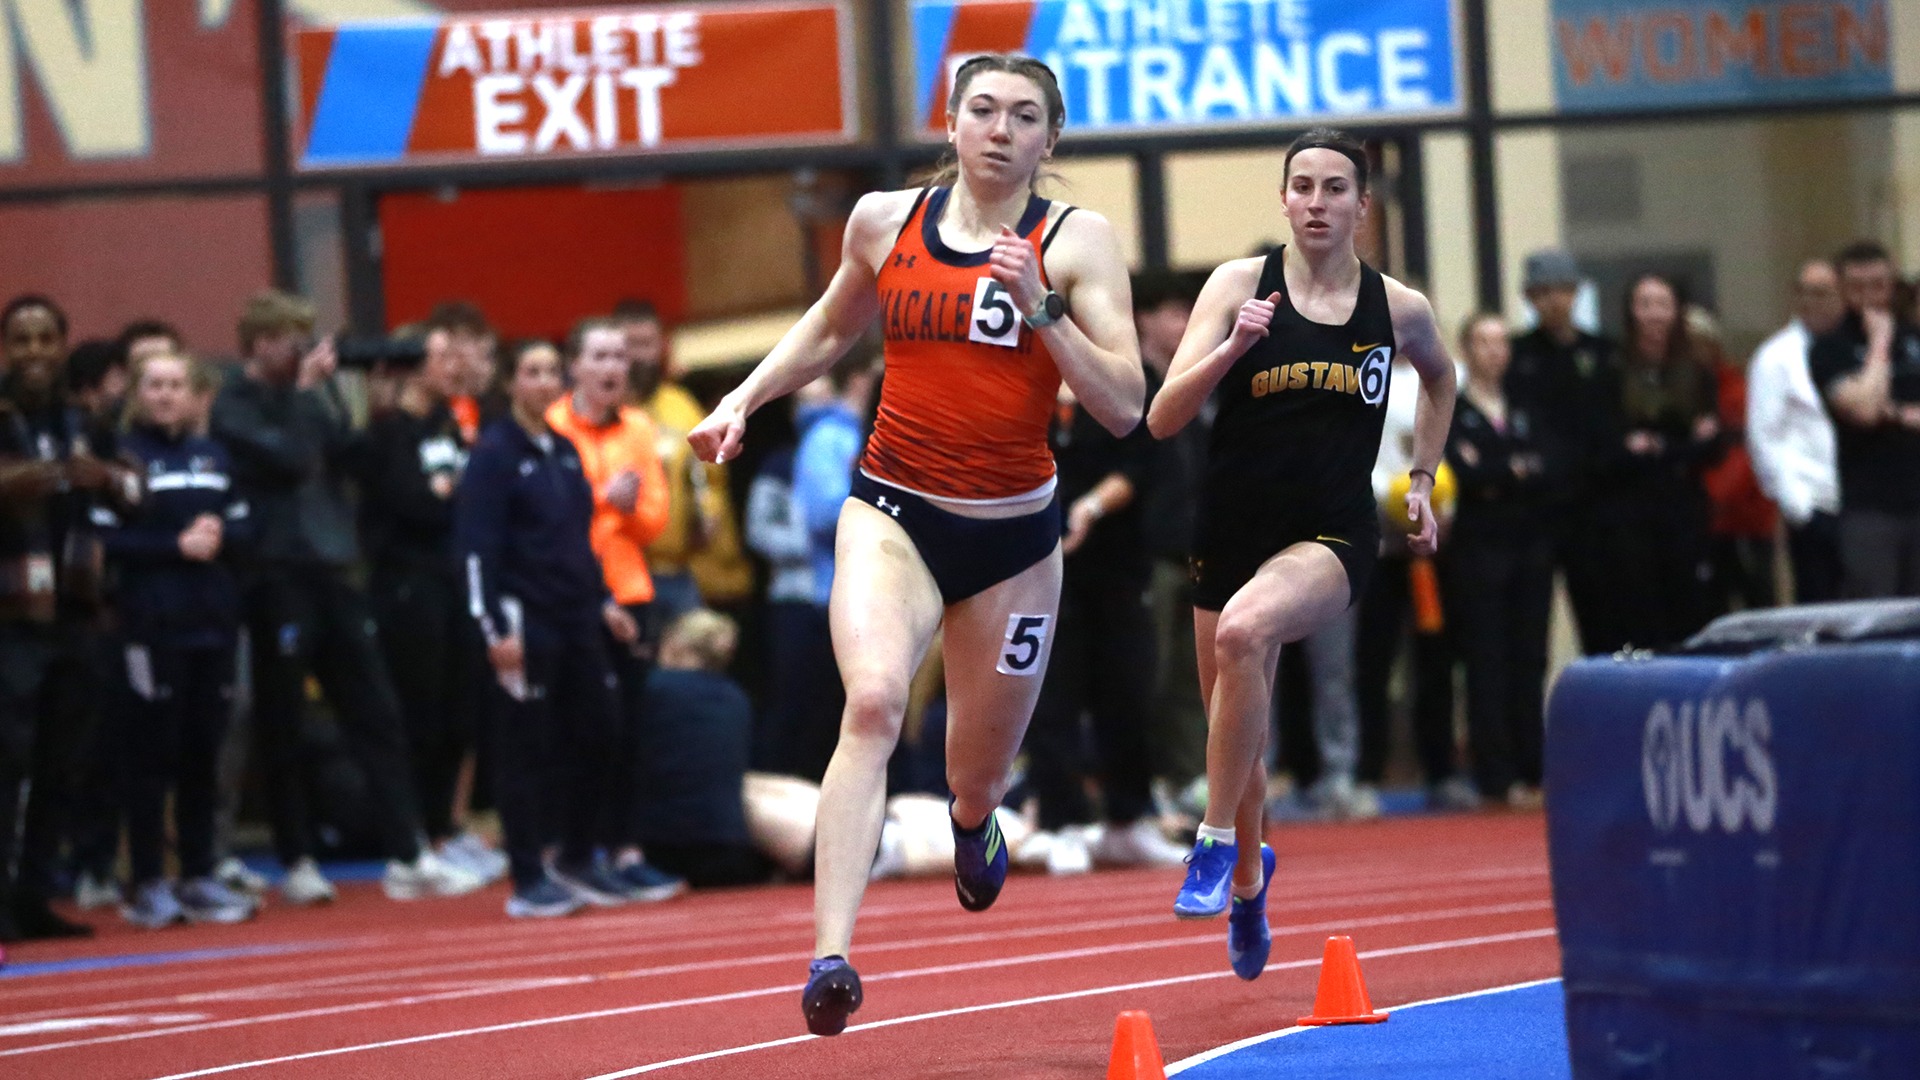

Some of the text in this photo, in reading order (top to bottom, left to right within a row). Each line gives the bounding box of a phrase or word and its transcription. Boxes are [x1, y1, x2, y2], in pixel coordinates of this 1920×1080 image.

[438, 14, 702, 77] ATHLETE
[1057, 0, 1310, 43] ATHLETE
[1558, 2, 1887, 87] WOMEN
[473, 67, 677, 156] EXIT
[976, 281, 1014, 337] 5
[1251, 361, 1364, 399] GUSTAV
[1361, 350, 1385, 400] 6
[1005, 617, 1044, 670] 5
[1680, 698, 1777, 833] UCS
